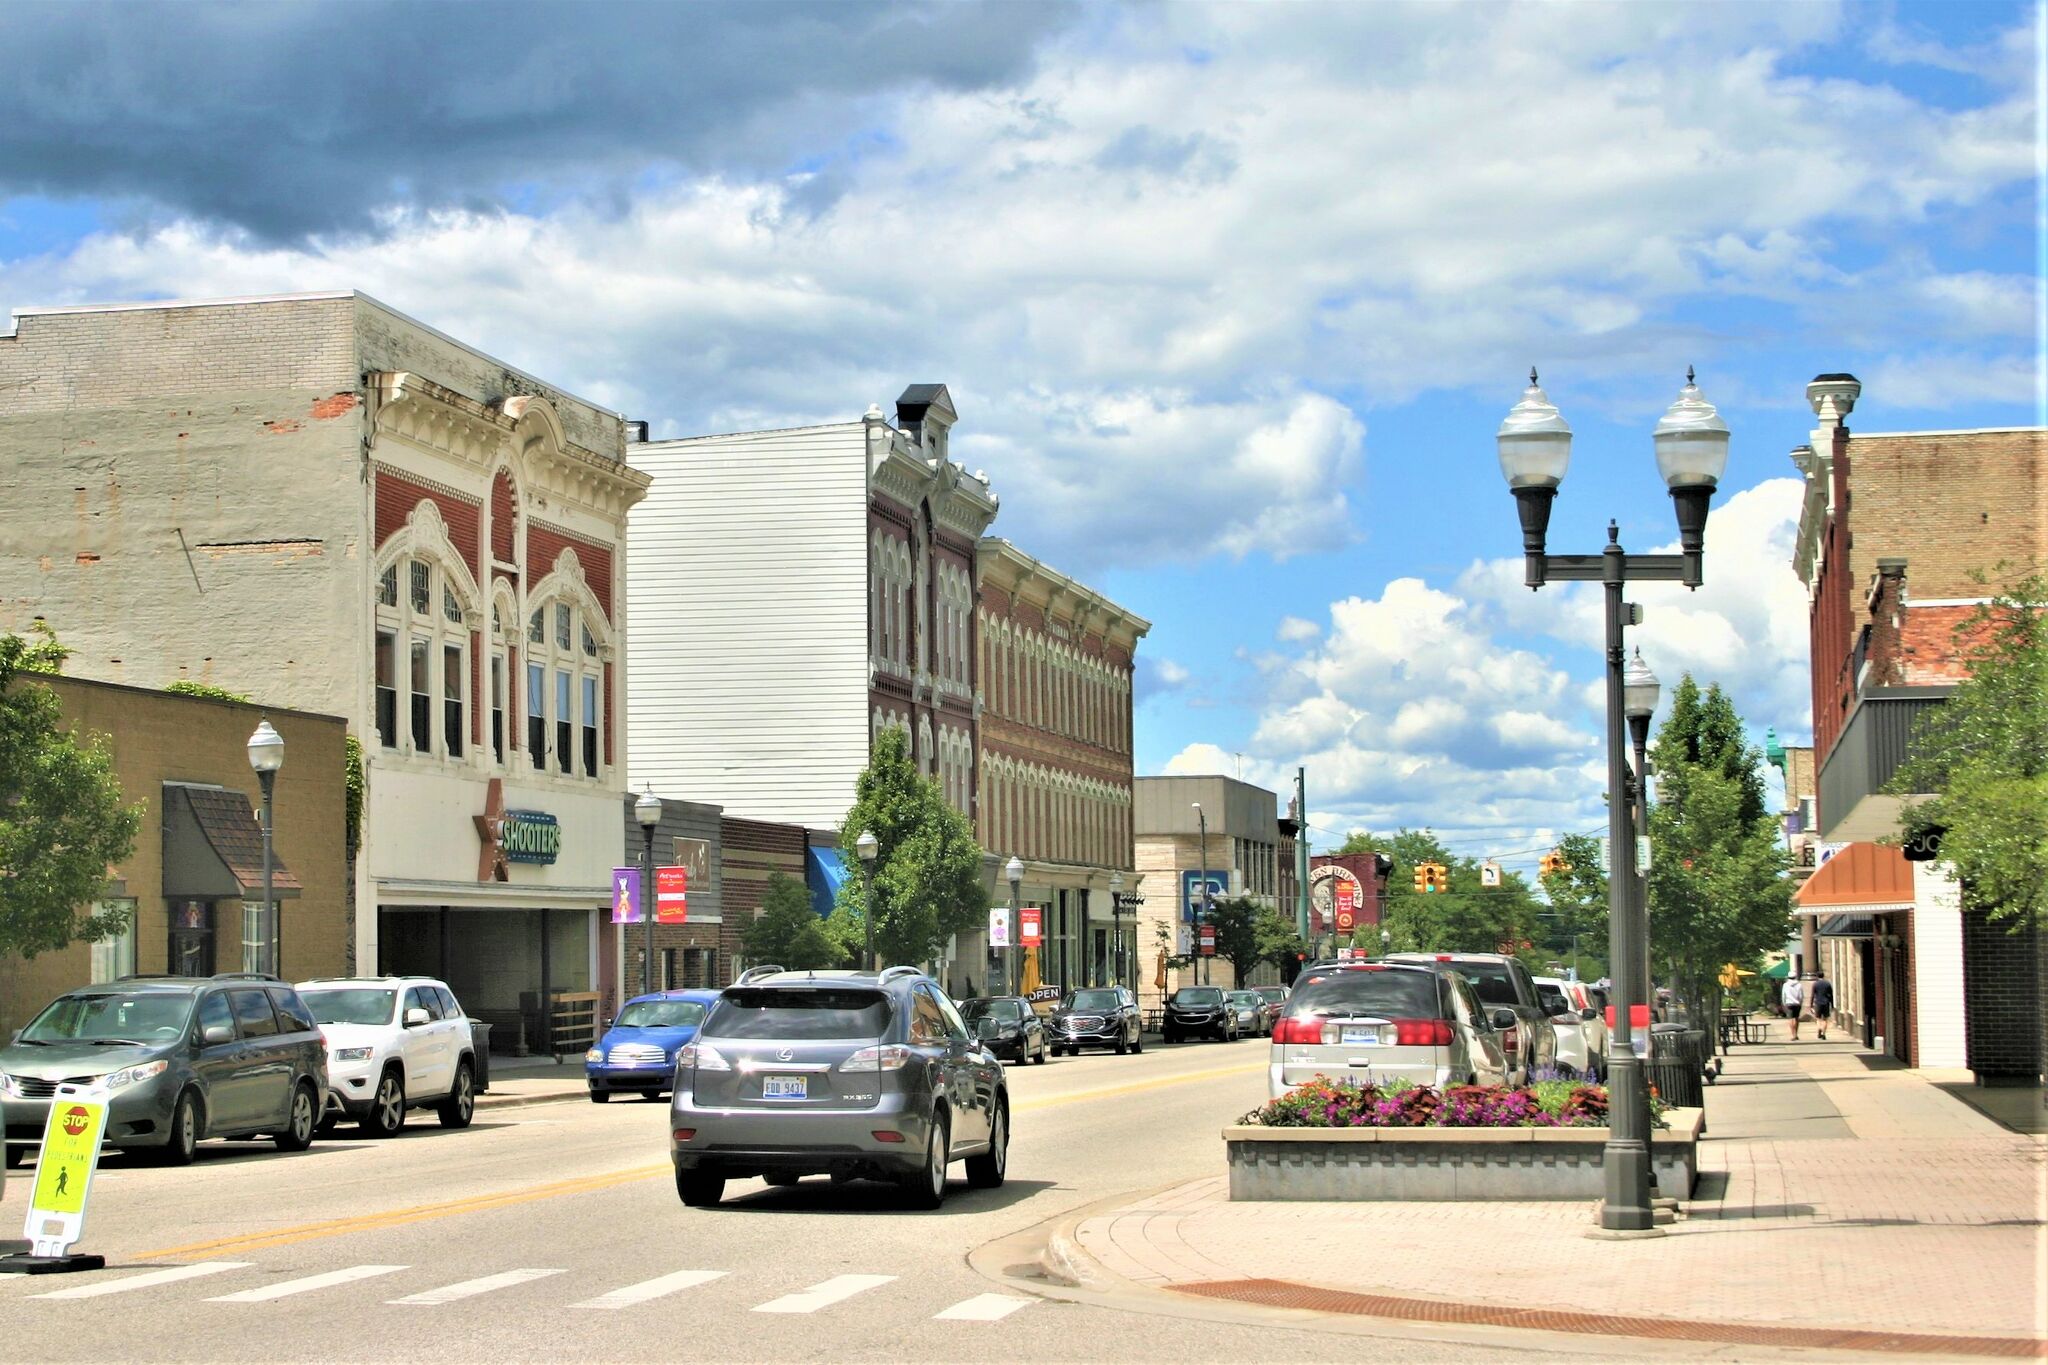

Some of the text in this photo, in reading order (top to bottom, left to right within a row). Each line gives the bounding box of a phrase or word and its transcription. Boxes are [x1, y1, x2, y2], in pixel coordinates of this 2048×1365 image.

[503, 820, 561, 854] SHOOTERS
[1029, 988, 1059, 1000] OPEN
[785, 1082, 804, 1093] 9437
[63, 1114, 90, 1127] STOP
